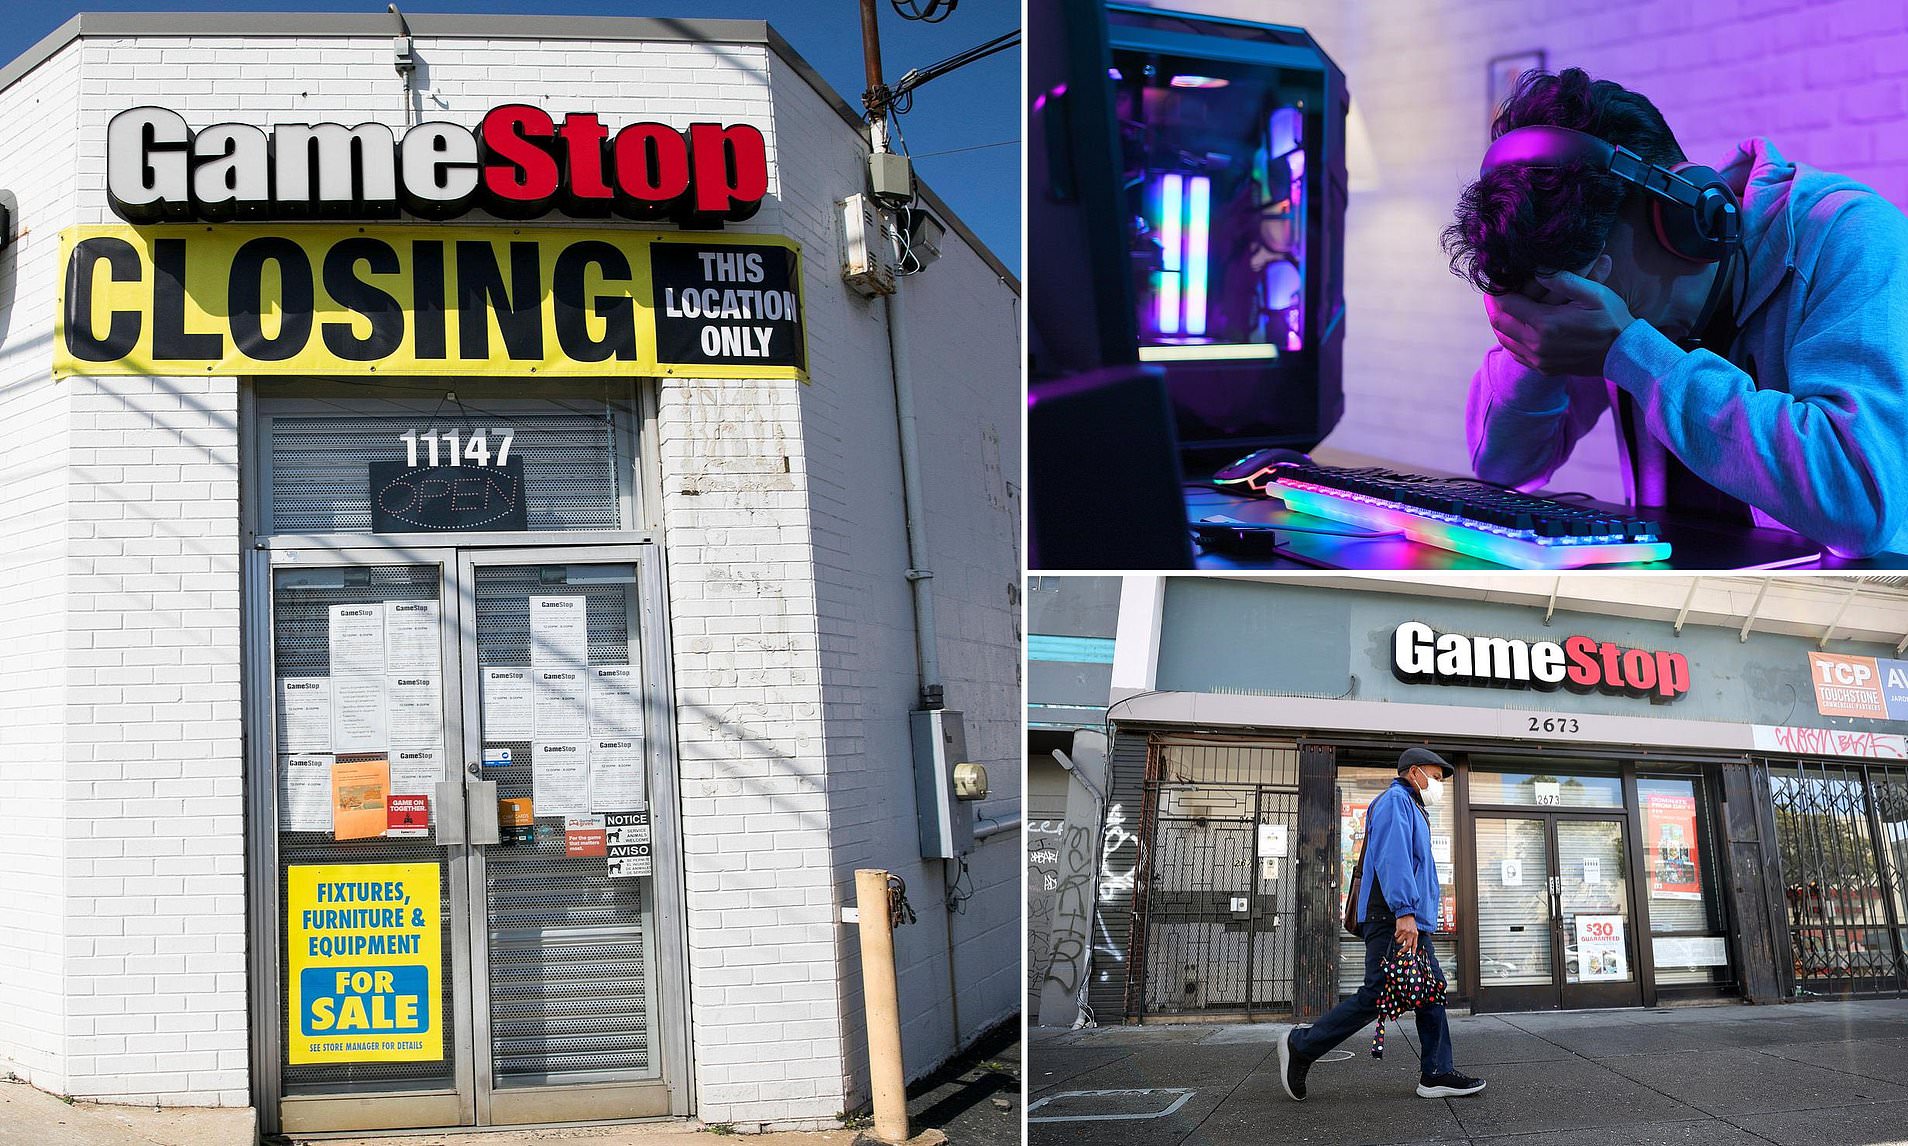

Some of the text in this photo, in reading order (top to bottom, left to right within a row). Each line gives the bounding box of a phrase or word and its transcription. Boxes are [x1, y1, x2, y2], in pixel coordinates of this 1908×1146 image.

[107, 104, 768, 216] GameStop
[698, 252, 765, 283] THIS
[64, 236, 637, 363] CLOSING
[665, 287, 797, 324] LOCATION
[700, 325, 773, 357] ONLY
[400, 428, 514, 467] 11147
[378, 474, 518, 514] OPEN
[340, 609, 373, 617] GameStop
[1395, 621, 1691, 697] GameStop
[398, 679, 430, 687] GameStop
[491, 672, 523, 680] GameStop
[1815, 660, 1871, 687] TCP
[287, 682, 320, 690] GameStop
[1819, 687, 1880, 705] TOUCHSTONE
[1528, 716, 1580, 733] 2673
[400, 752, 433, 760] GameStop
[544, 745, 576, 753] GameStop
[1537, 795, 1560, 805] 2673
[607, 814, 648, 825] NOTICE
[609, 845, 649, 857] AVISO
[317, 881, 410, 906] FIXTURES,
[302, 907, 426, 930] FURNITURE &
[1586, 922, 1614, 936] $30
[309, 934, 420, 959] EQUIPMENT
[335, 971, 395, 995] FOR
[311, 994, 419, 1031] SALE
[309, 1040, 423, 1052] SEE STORE MANAGER FOR DETAILS
